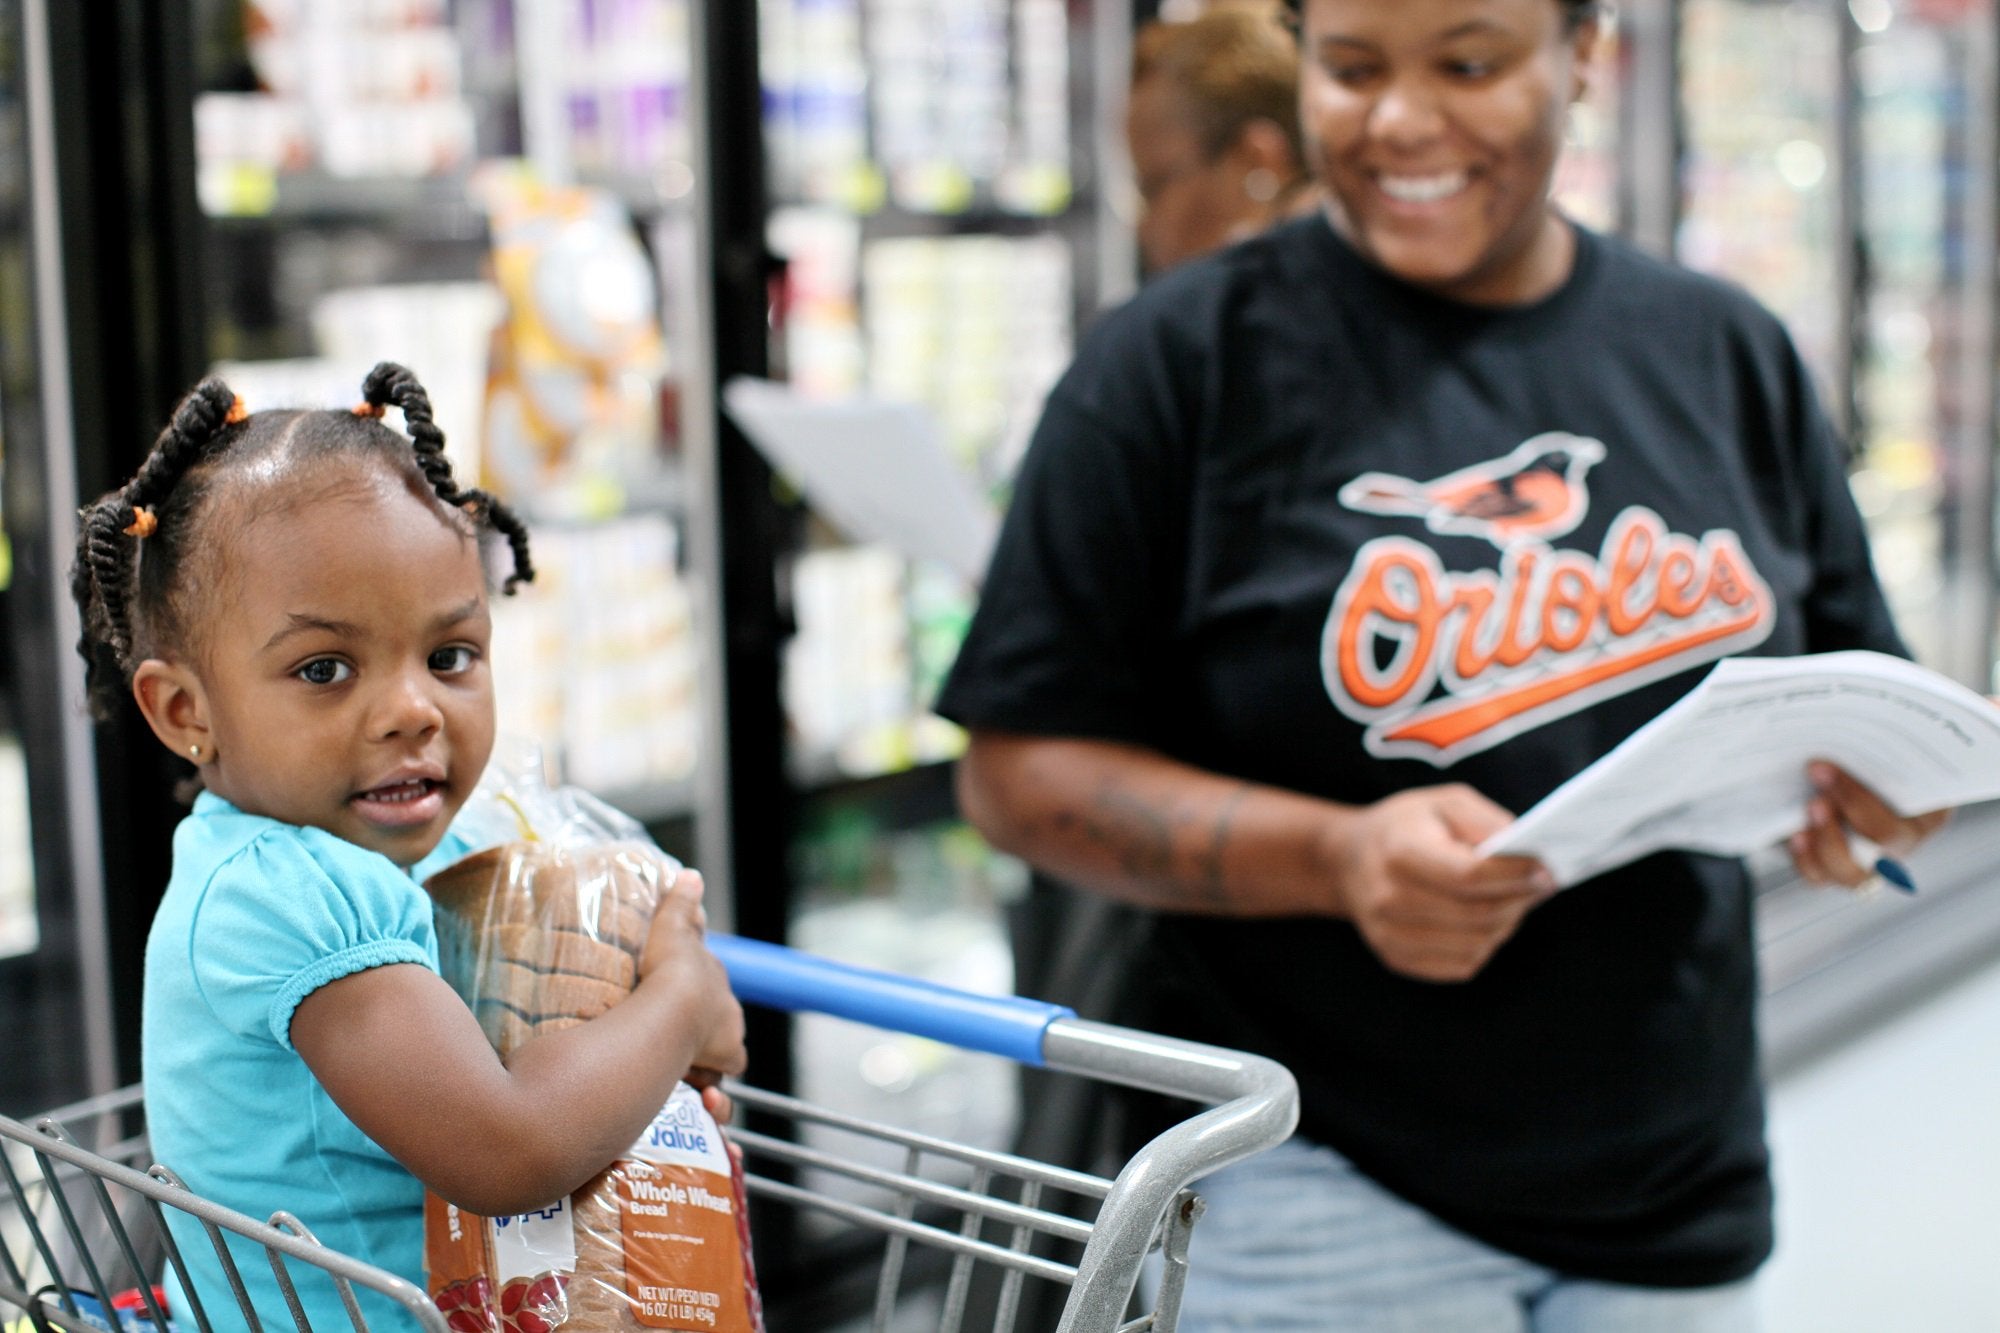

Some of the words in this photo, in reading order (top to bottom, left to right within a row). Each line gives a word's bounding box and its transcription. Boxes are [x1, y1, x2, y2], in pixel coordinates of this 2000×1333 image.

[1321, 505, 1777, 725] Orioles
[629, 1180, 687, 1205] Whole
[687, 1186, 732, 1215] Wheat
[630, 1201, 668, 1217] Bread
[638, 1286, 657, 1300] NET
[641, 1302, 653, 1316] 16
[654, 1303, 667, 1317] OZ
